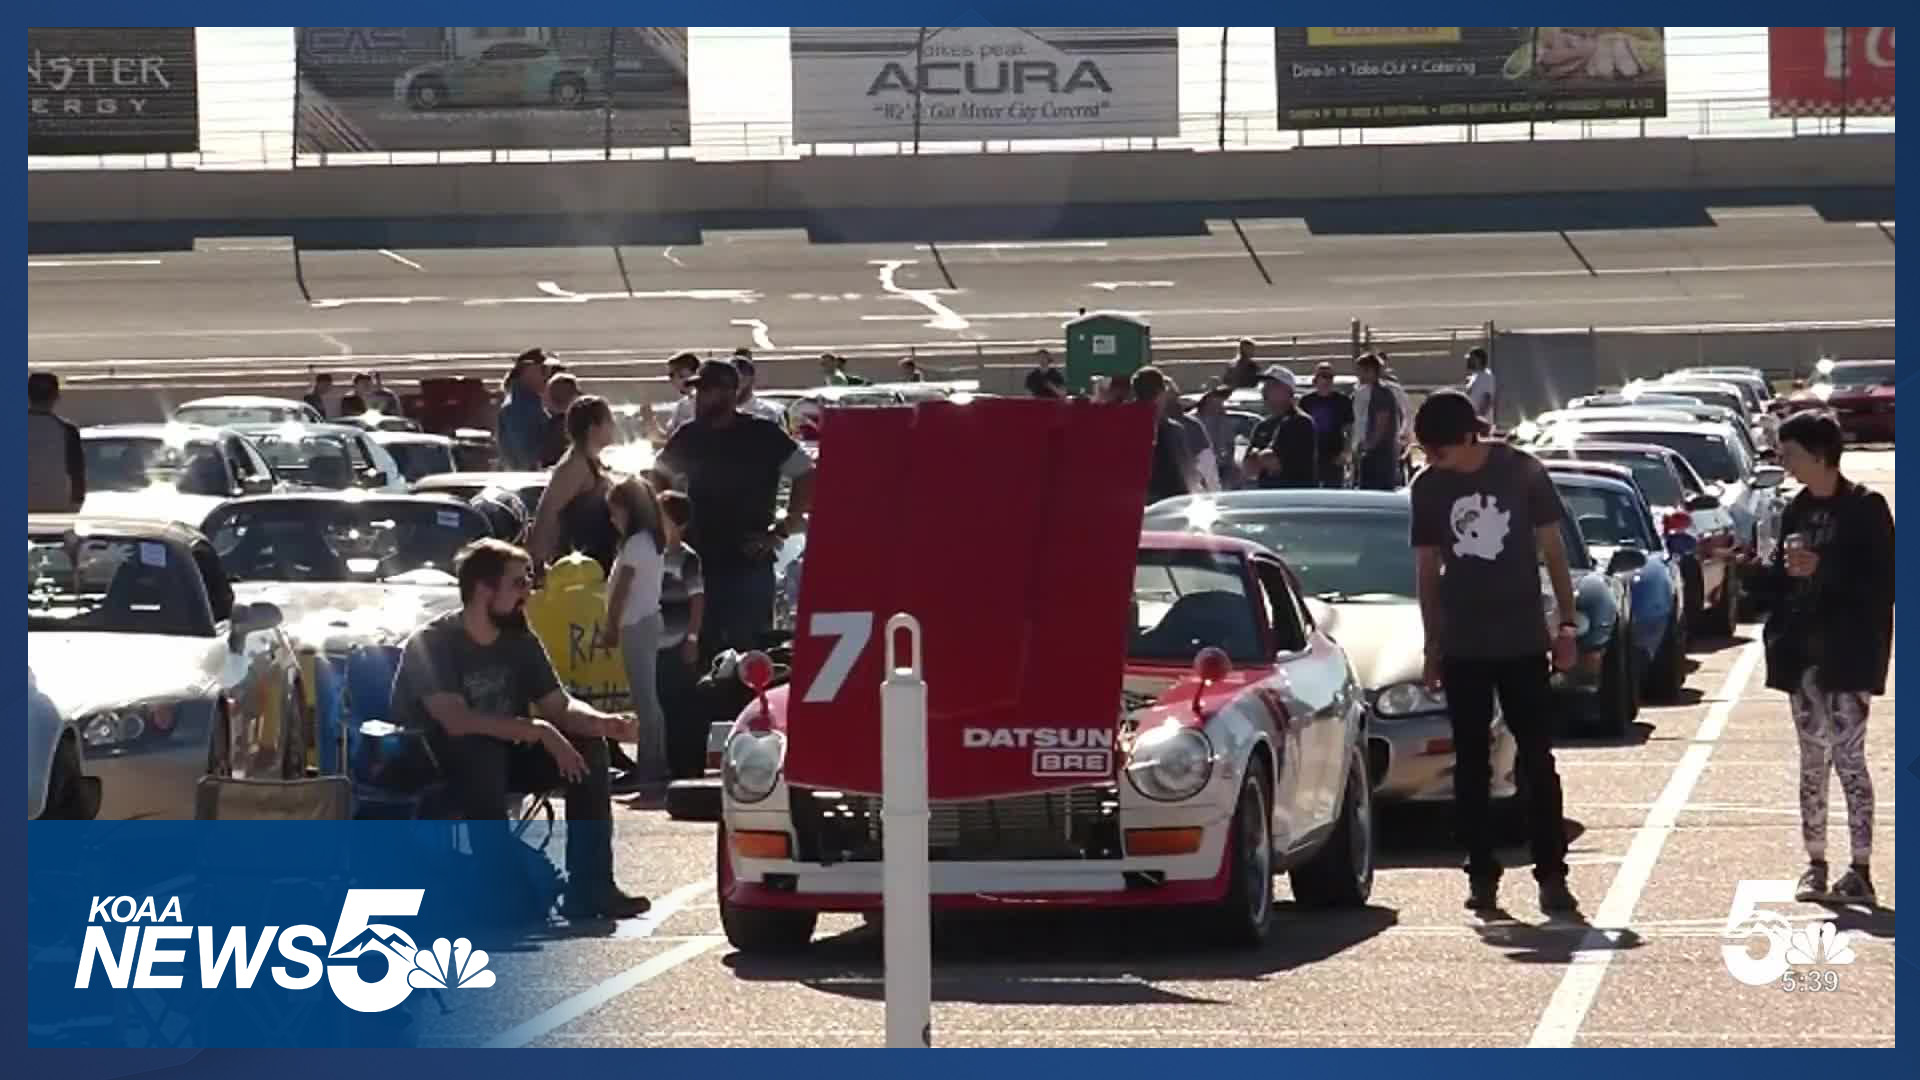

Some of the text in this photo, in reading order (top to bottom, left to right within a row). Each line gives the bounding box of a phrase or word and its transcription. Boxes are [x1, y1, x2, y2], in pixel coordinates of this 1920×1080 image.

[866, 60, 1113, 96] ACURA
[802, 611, 873, 702] 7
[962, 727, 1112, 748] DATSUN
[1040, 753, 1105, 771] BRE
